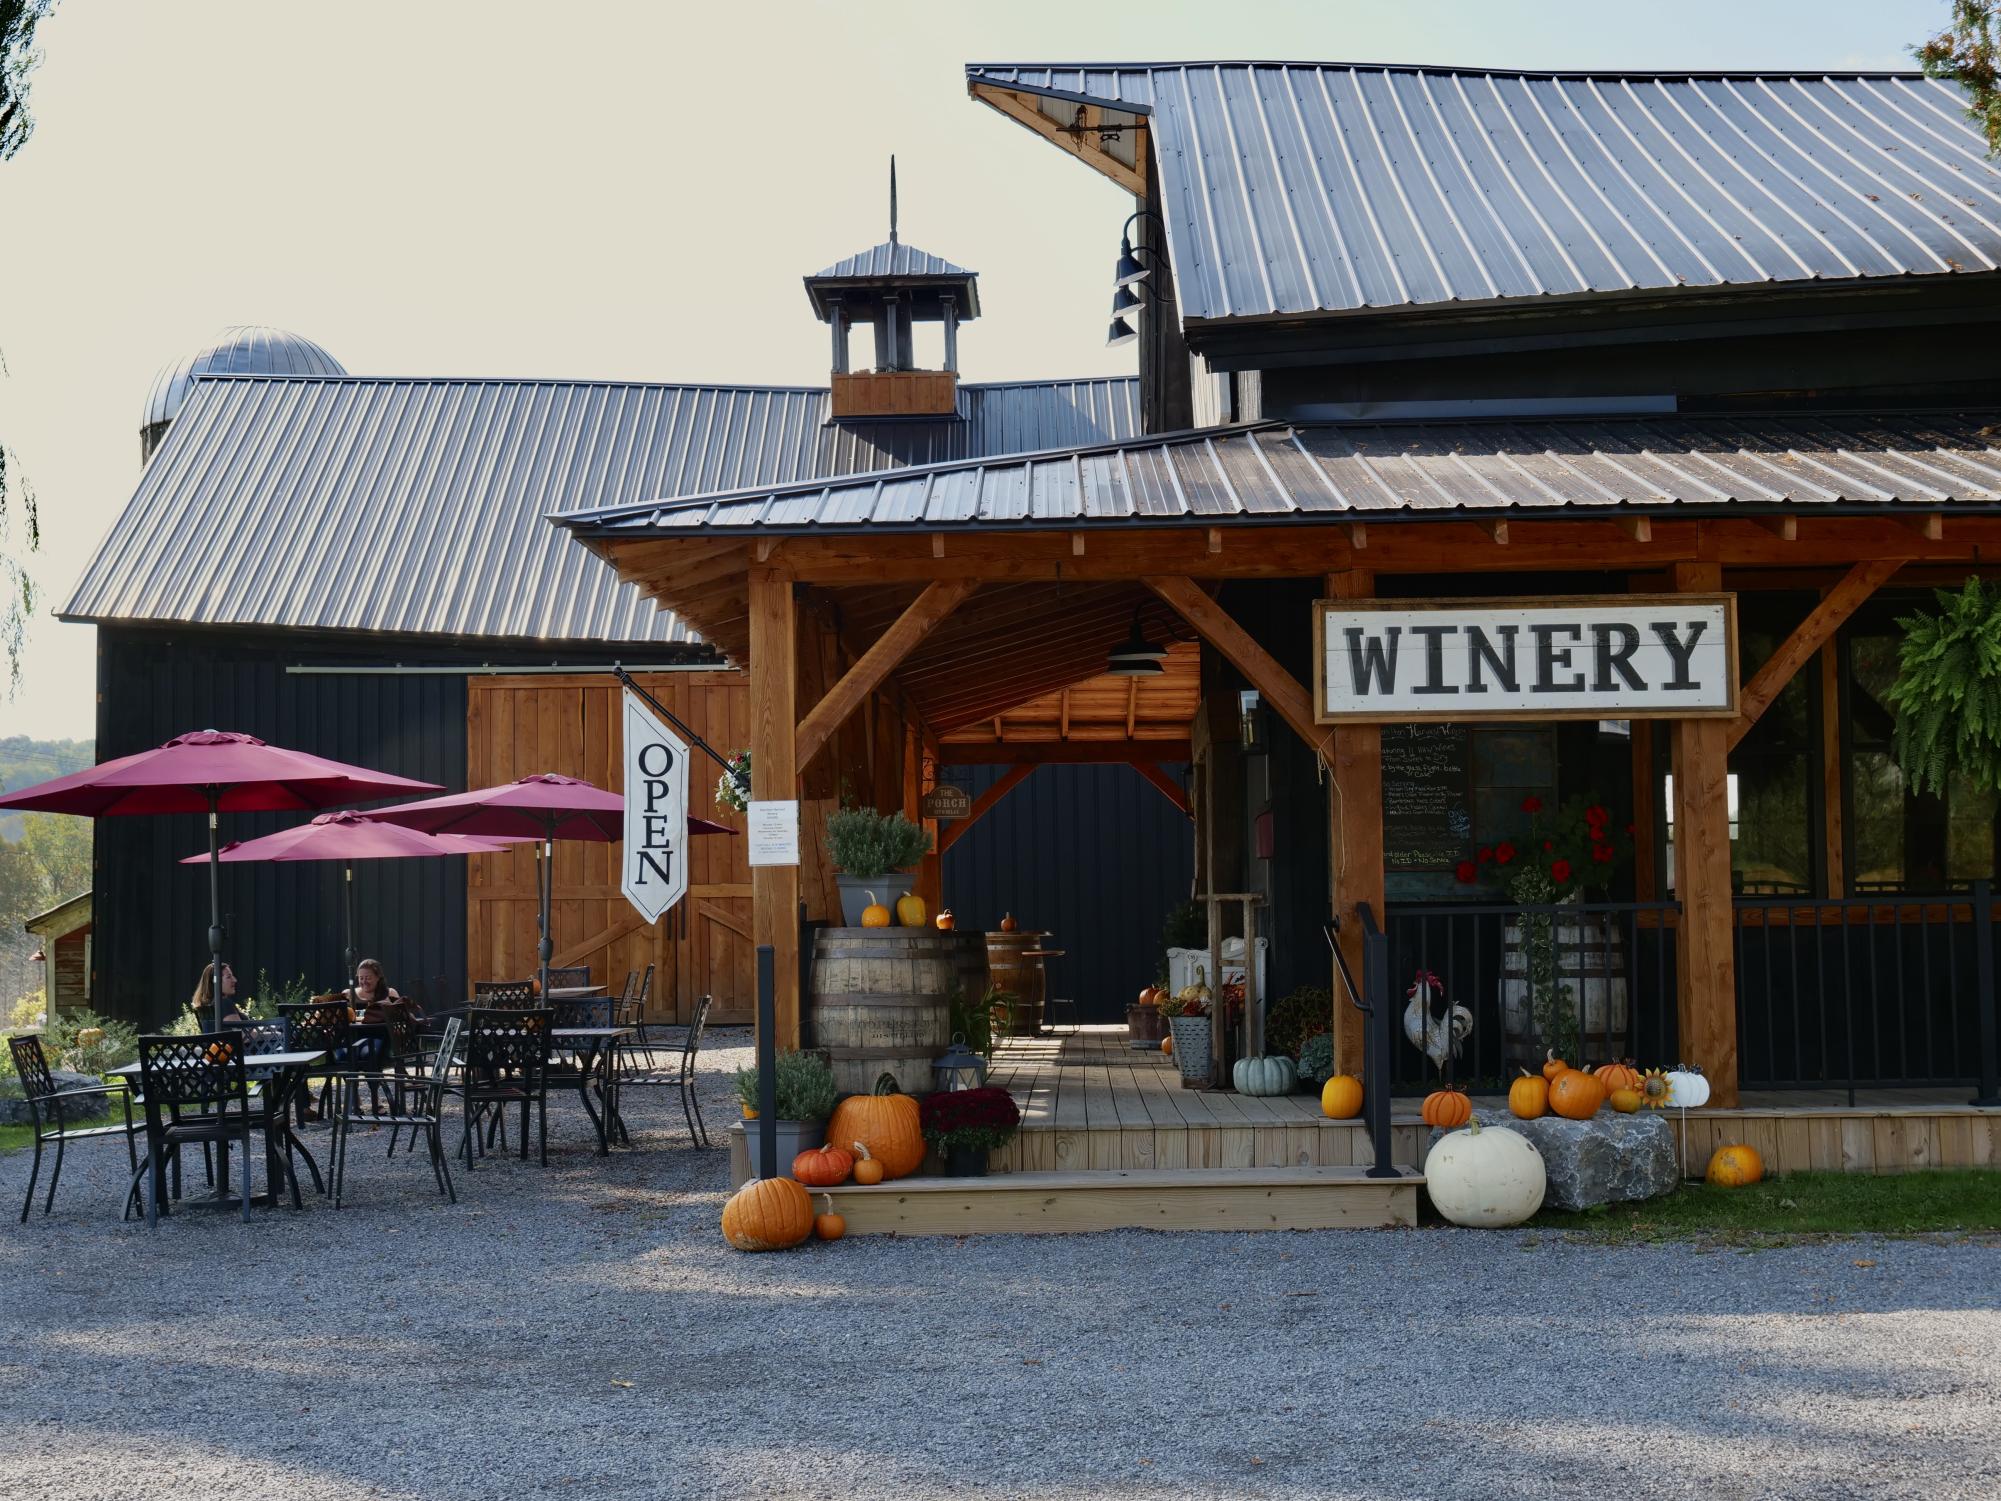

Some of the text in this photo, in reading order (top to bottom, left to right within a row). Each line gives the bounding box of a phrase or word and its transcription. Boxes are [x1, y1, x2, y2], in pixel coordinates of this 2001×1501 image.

[1342, 620, 1708, 696] WINERY
[634, 743, 674, 885] OPEN
[927, 798, 967, 808] PORCH
